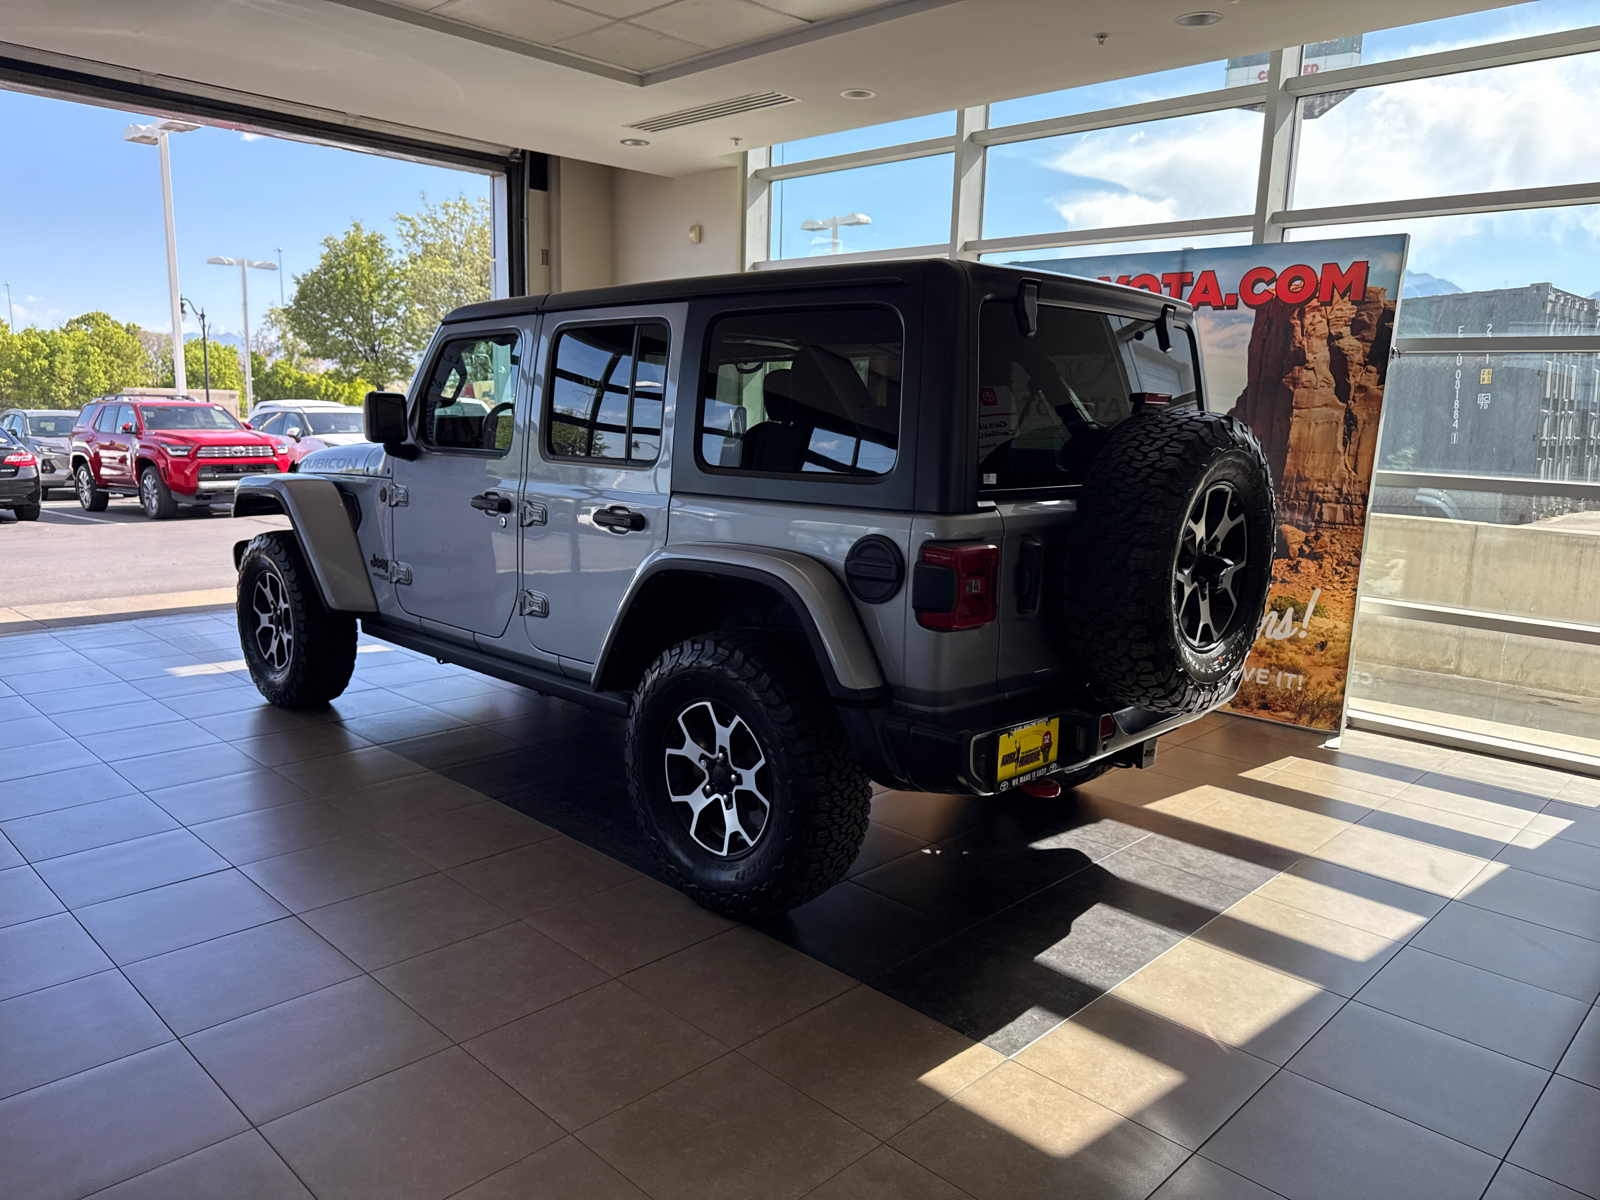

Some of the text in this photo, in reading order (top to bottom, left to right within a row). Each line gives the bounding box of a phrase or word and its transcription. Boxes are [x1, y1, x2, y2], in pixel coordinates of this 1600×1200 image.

[300, 457, 358, 469] RUBICON
[370, 553, 389, 574] Jeep
[1256, 587, 1322, 641] ns!
[1242, 667, 1304, 691] VE IT!
[1043, 734, 1050, 744] 32
[1011, 777, 1019, 787] WE
[1019, 773, 1031, 784] MAKE
[1037, 767, 1047, 777] EASY
